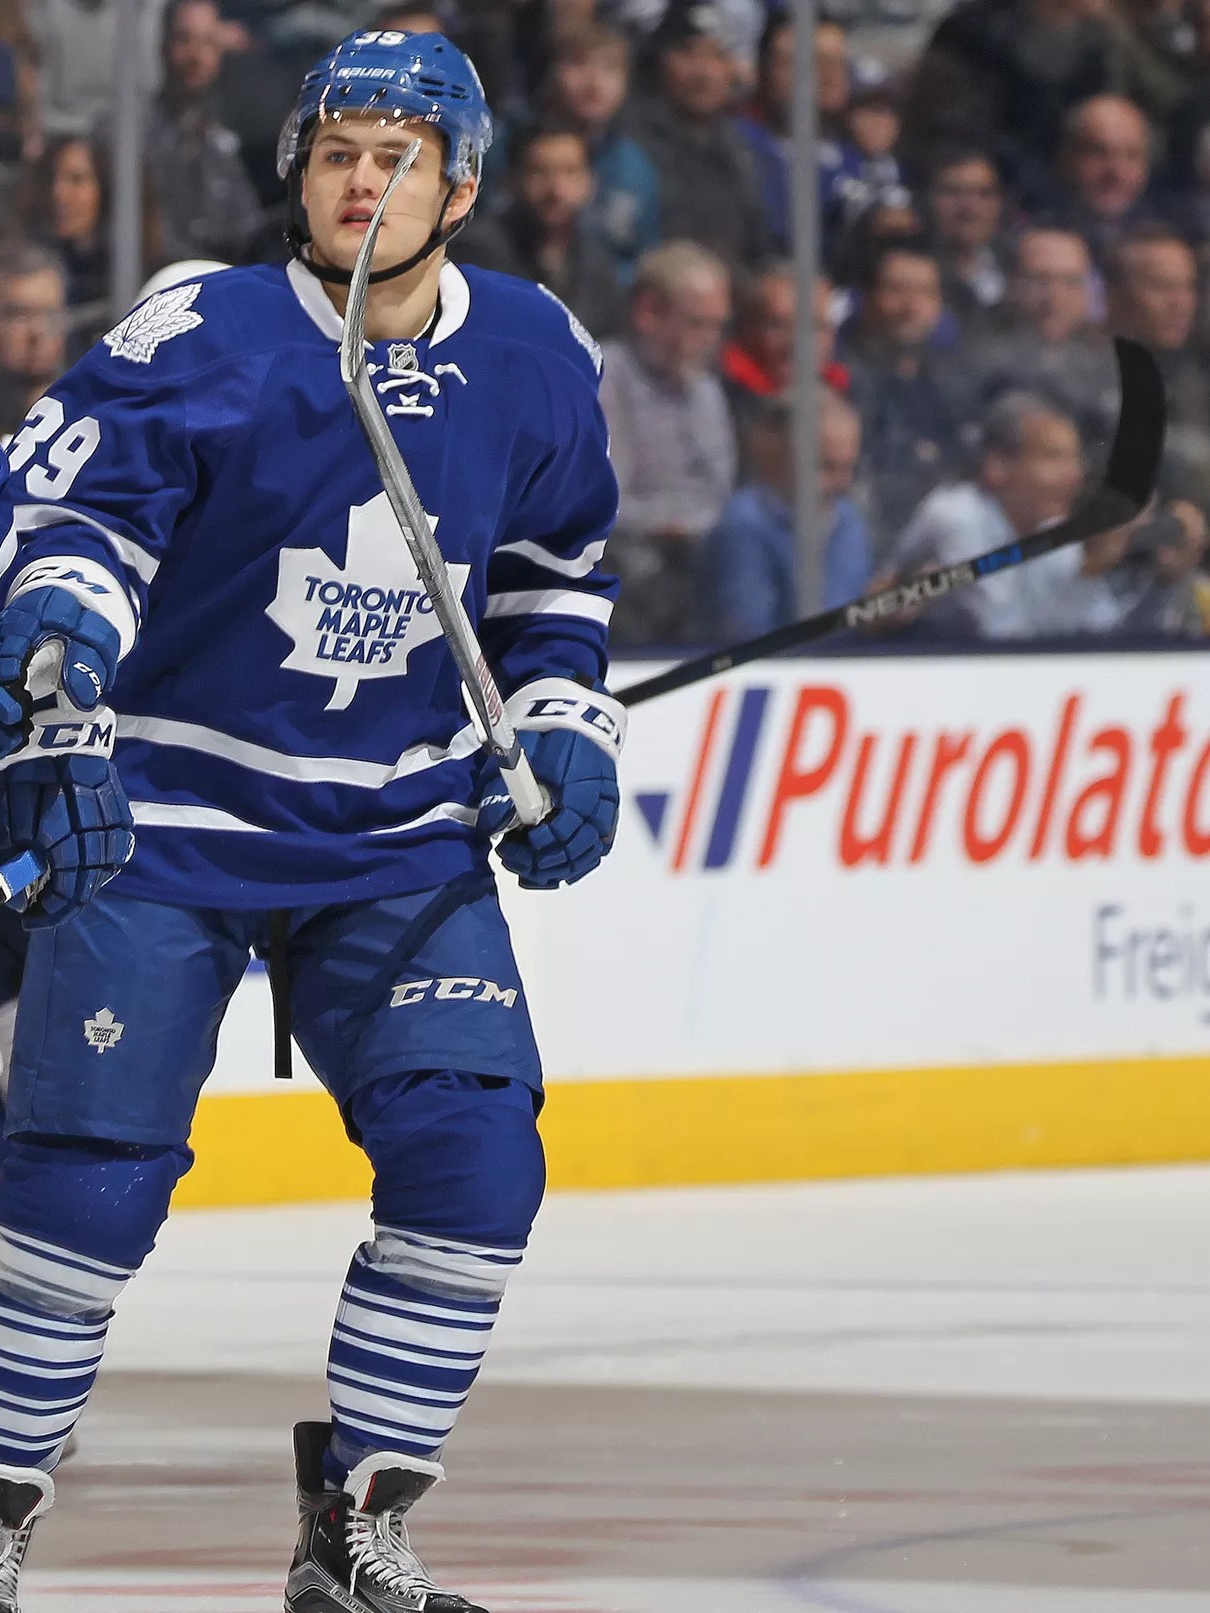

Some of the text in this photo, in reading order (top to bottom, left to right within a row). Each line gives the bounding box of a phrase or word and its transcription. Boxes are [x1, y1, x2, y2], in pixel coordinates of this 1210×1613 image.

[355, 30, 407, 47] 39
[8, 396, 102, 500] 39
[304, 575, 435, 615] TORONTO
[846, 562, 976, 628] NEXUS
[315, 607, 412, 640] MAPLE
[315, 634, 398, 665] LEAFS
[390, 977, 518, 1009] CCM
